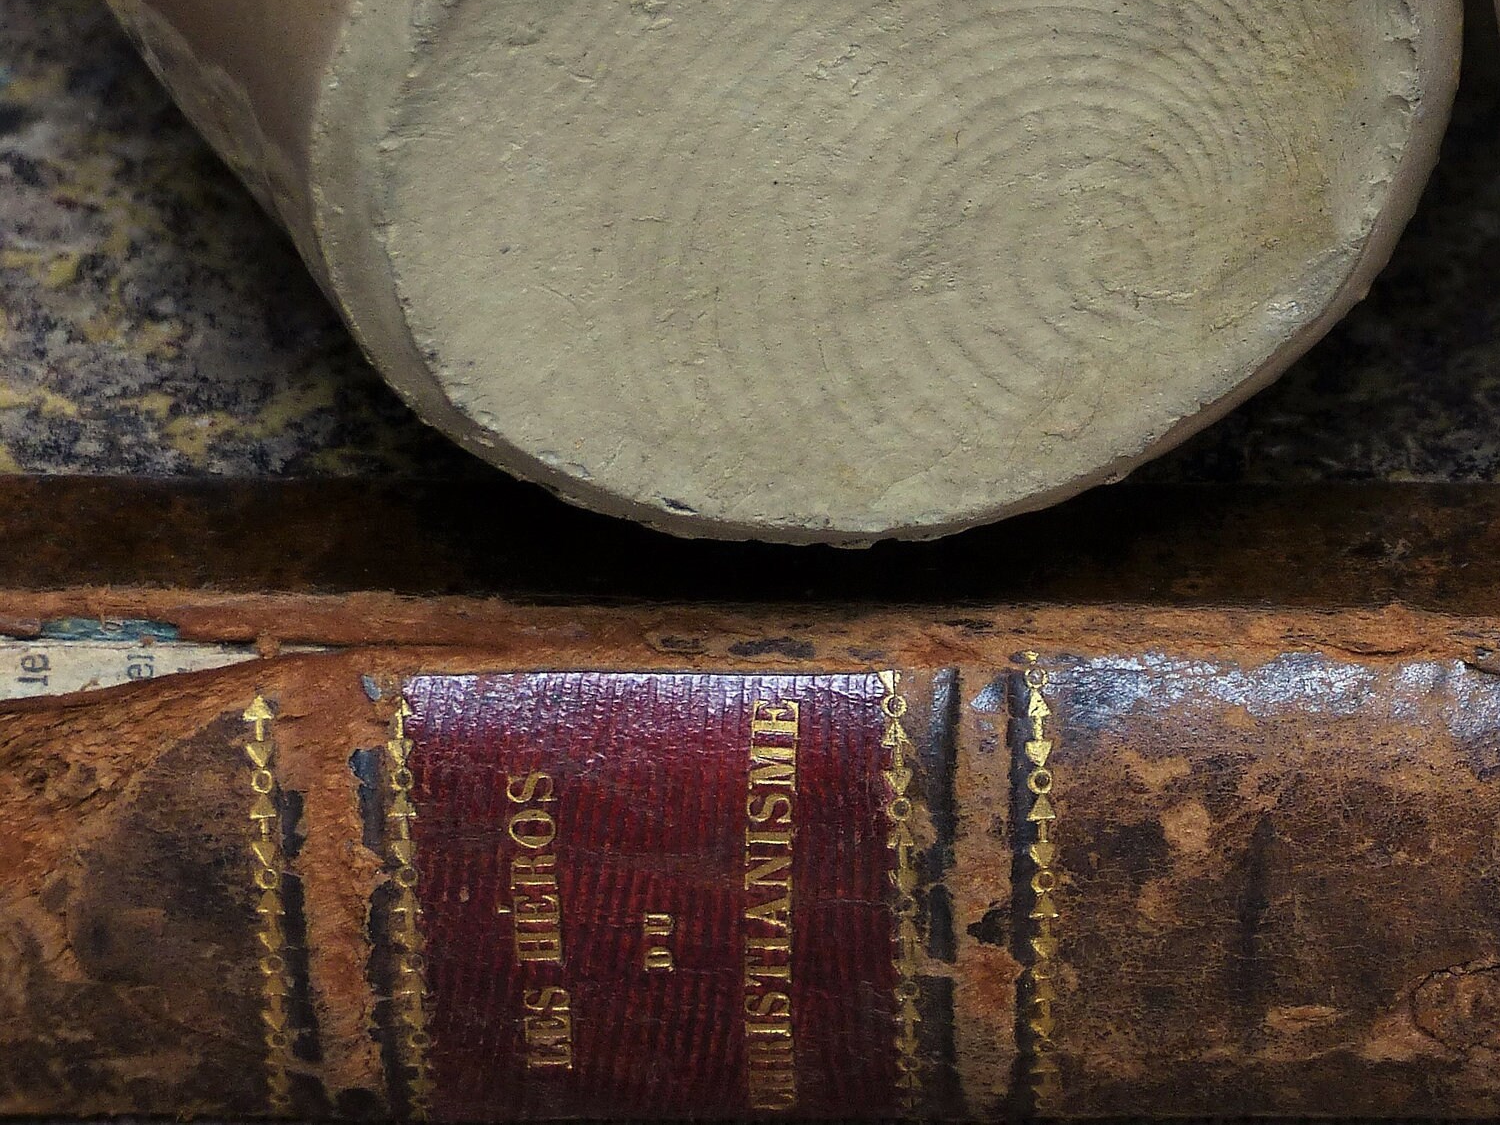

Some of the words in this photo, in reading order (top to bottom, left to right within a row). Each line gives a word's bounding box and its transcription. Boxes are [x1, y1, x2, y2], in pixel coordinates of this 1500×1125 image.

[498, 769, 564, 965] HÉROS
[742, 698, 800, 1111] CHRISTIANISME
[643, 911, 675, 973] DU
[522, 986, 573, 1069] LES
